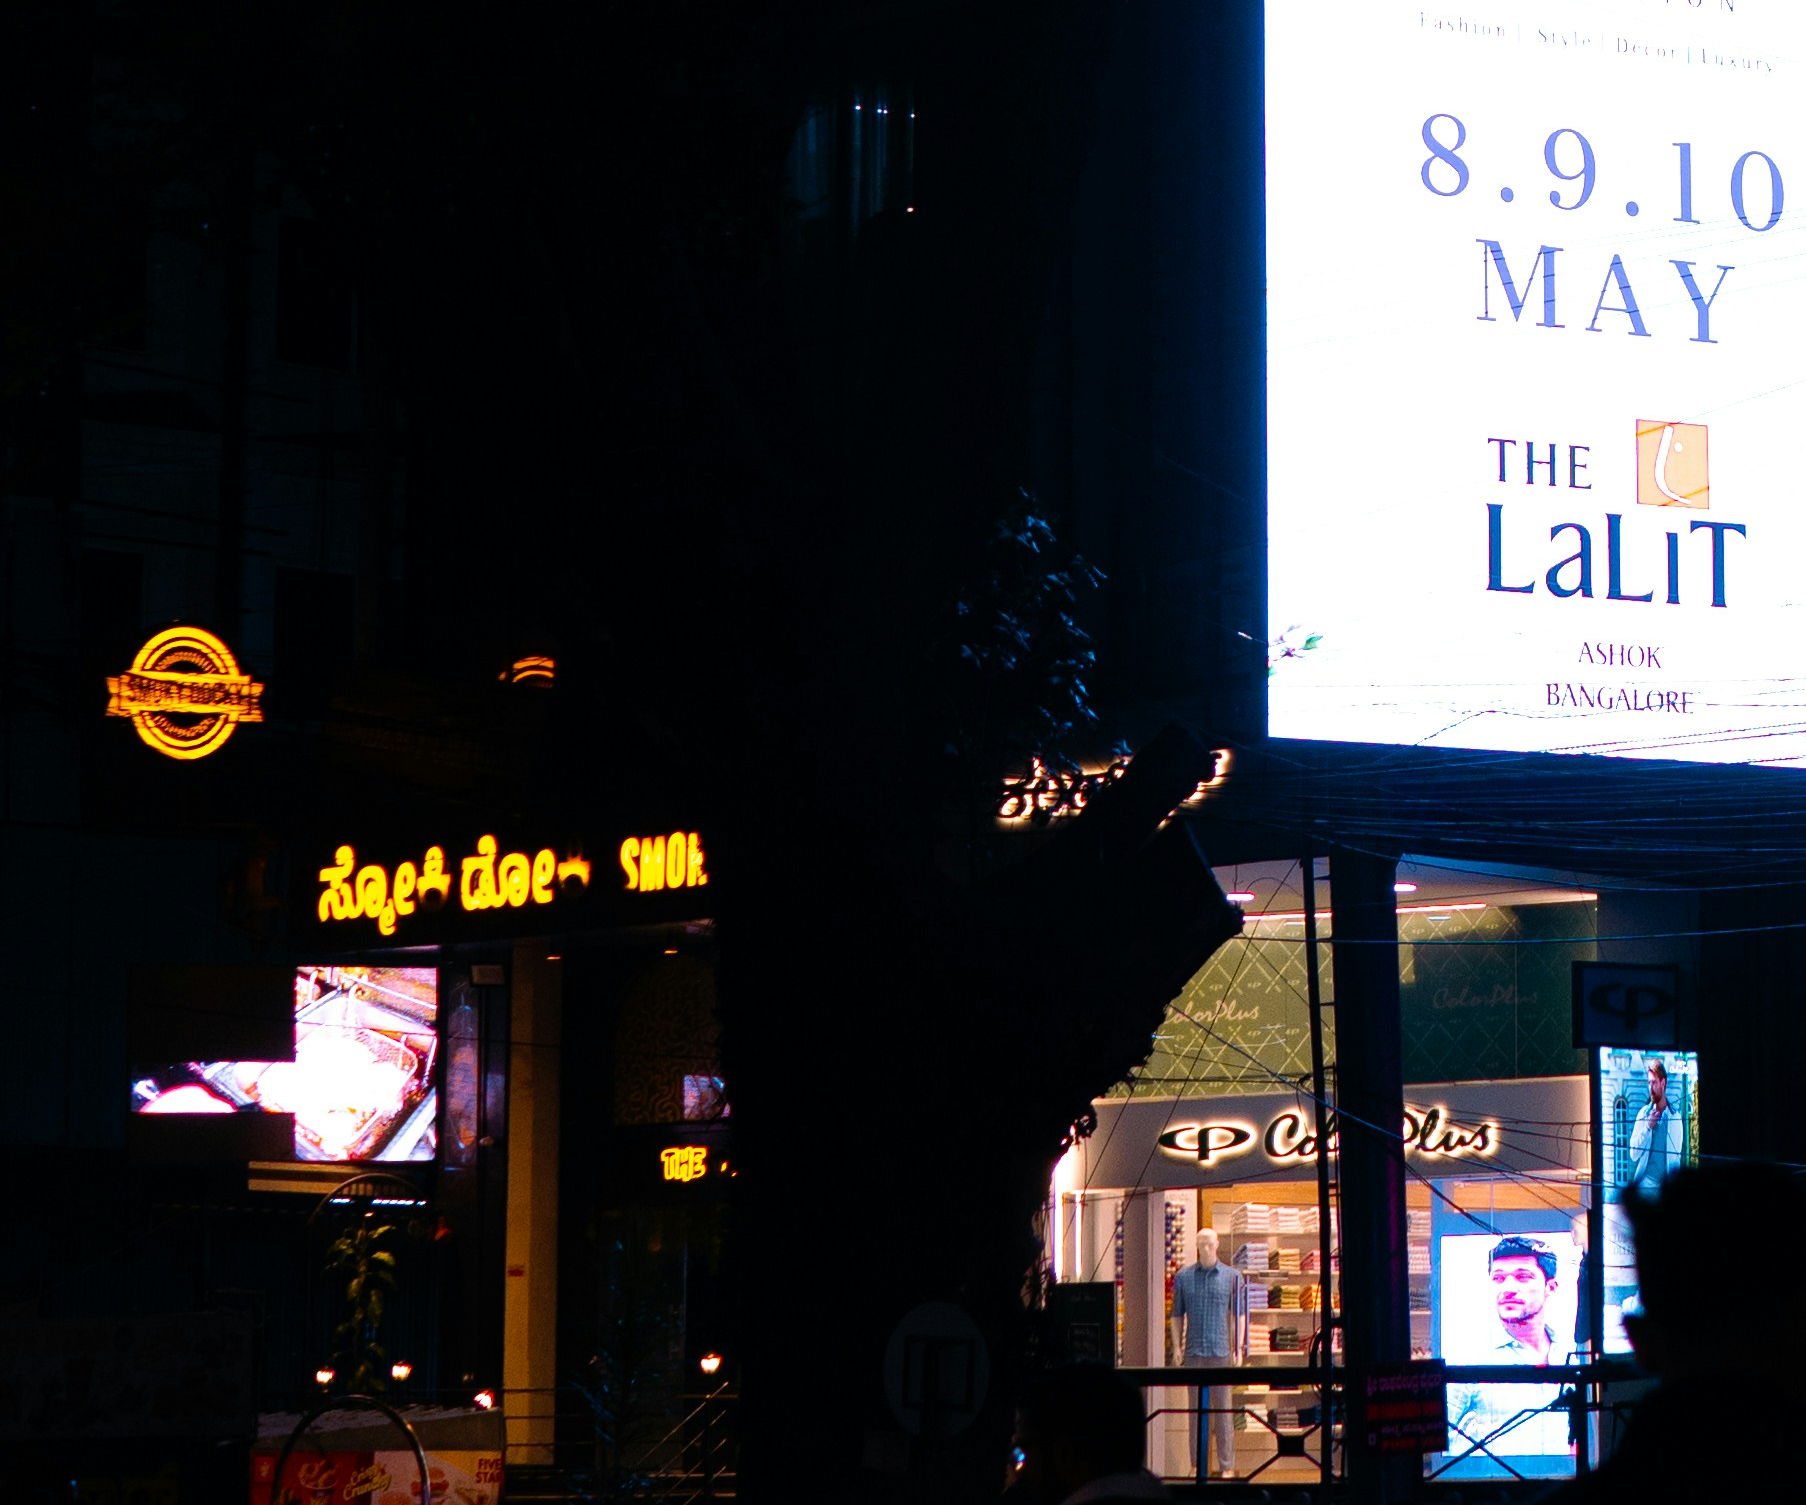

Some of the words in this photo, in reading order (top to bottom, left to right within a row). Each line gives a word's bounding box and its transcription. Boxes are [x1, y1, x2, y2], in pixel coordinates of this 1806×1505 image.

[1420, 112, 1785, 233] 8.9.10
[1475, 237, 1735, 345] MAY
[1487, 437, 1594, 491] THE
[1578, 640, 1662, 670] ASHOK
[1545, 682, 1695, 715] BANGALORE
